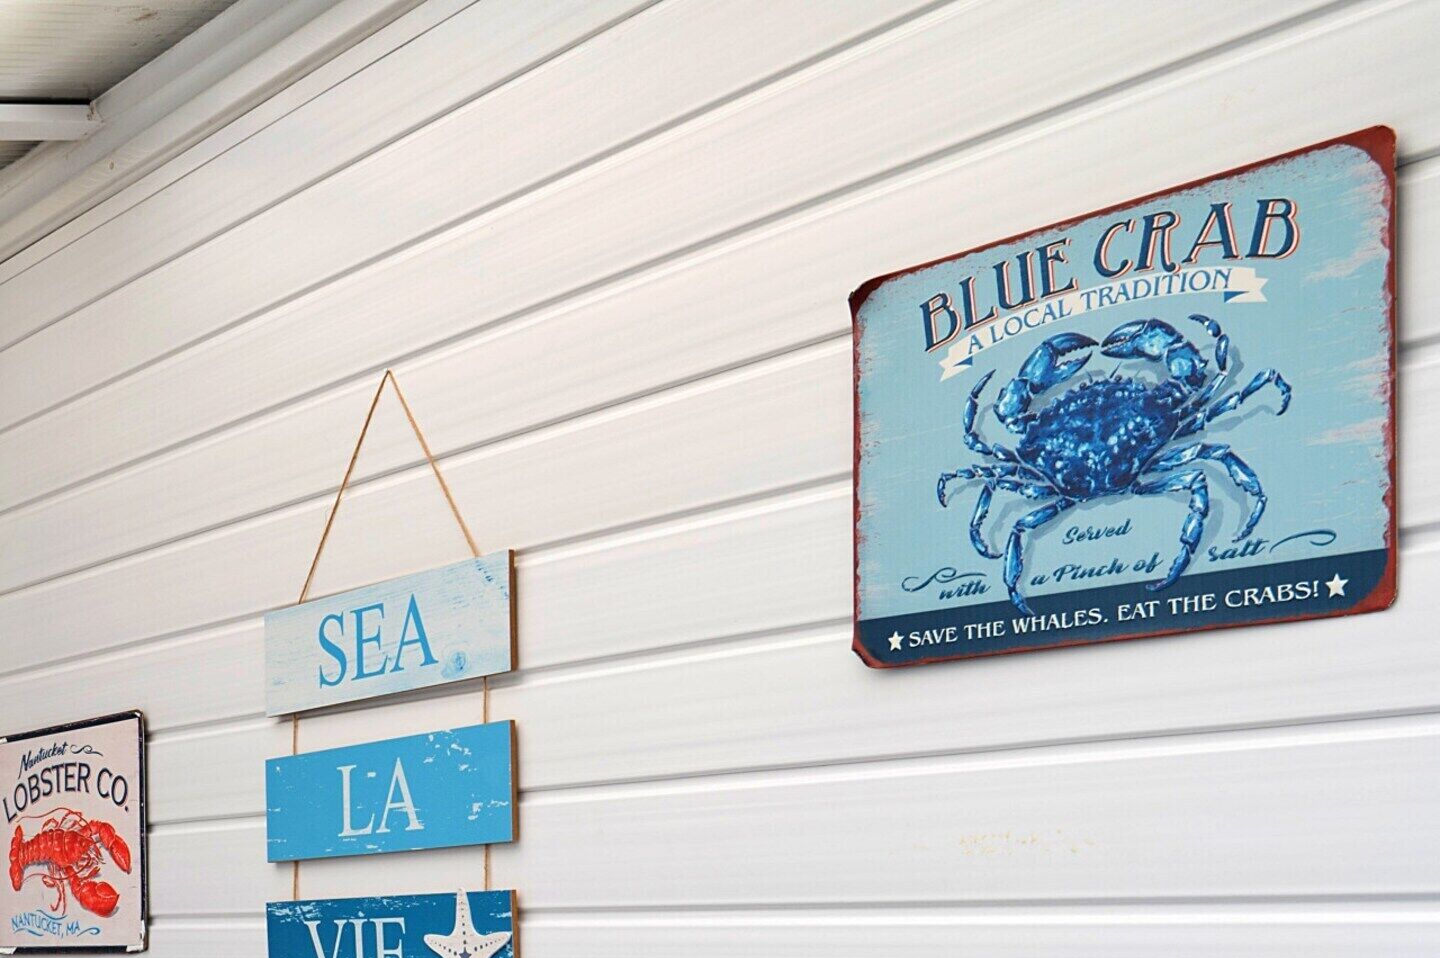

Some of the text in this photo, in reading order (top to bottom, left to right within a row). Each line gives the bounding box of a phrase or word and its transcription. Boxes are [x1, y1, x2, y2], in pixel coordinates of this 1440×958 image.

[919, 197, 1301, 354] BLUE CRAB
[967, 268, 1235, 355] A LOCAL TRADITION
[1062, 518, 1132, 546] Served
[938, 579, 991, 601] with
[1031, 573, 1049, 587] a
[1053, 559, 1128, 585] Pinch
[1133, 551, 1163, 576] of
[317, 593, 439, 689] SEA
[908, 580, 1320, 648] SAVE THE WHALES. EAT THE CRABS!
[2, 762, 129, 823] LOBSTER CO.
[18, 741, 69, 778] Nantucket
[337, 757, 424, 838] LA
